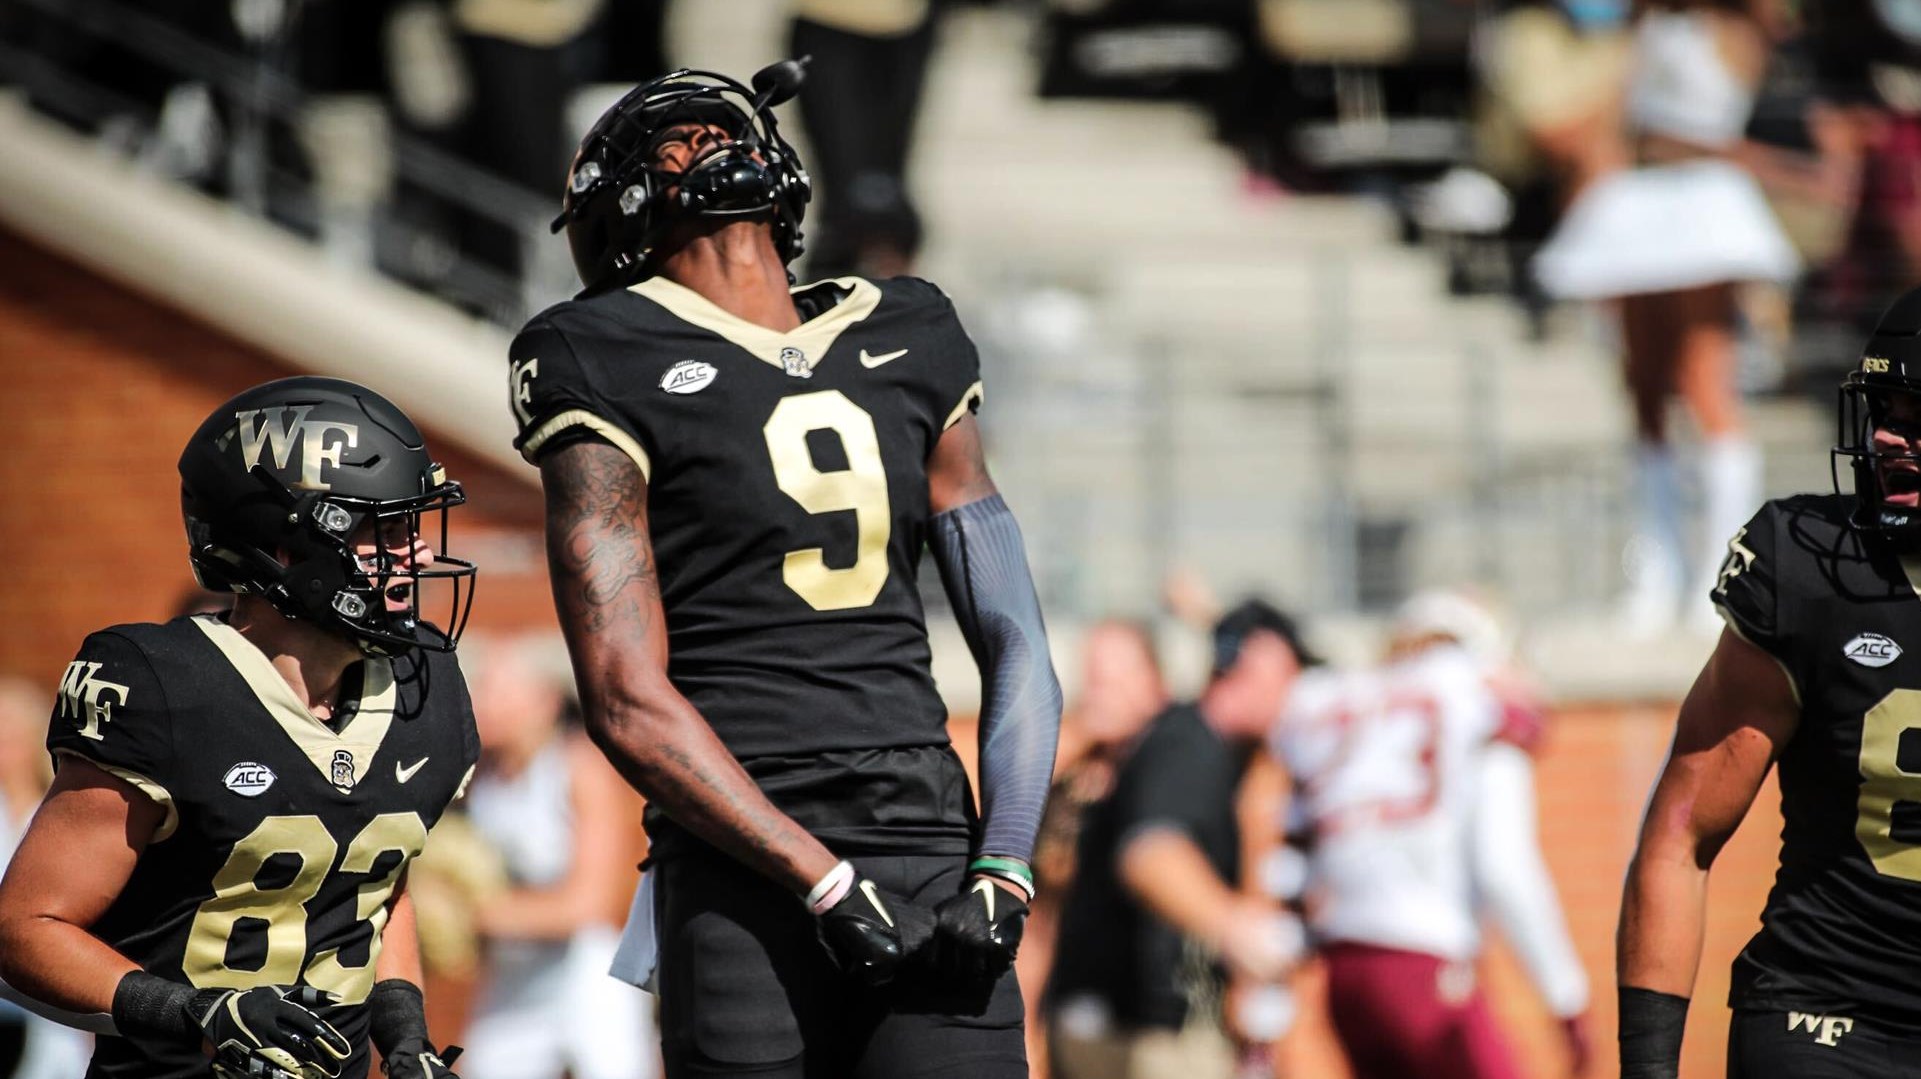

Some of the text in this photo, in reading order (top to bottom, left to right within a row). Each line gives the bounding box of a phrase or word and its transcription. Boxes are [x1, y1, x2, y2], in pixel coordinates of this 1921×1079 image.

[511, 358, 538, 426] F
[670, 366, 707, 386] ACC
[235, 405, 358, 491] WF
[763, 389, 891, 612] 9
[1852, 643, 1893, 656] ACC
[59, 661, 129, 741] WF
[231, 771, 267, 784] ACC
[182, 811, 427, 1007] 83
[1787, 1011, 1853, 1046] WF
